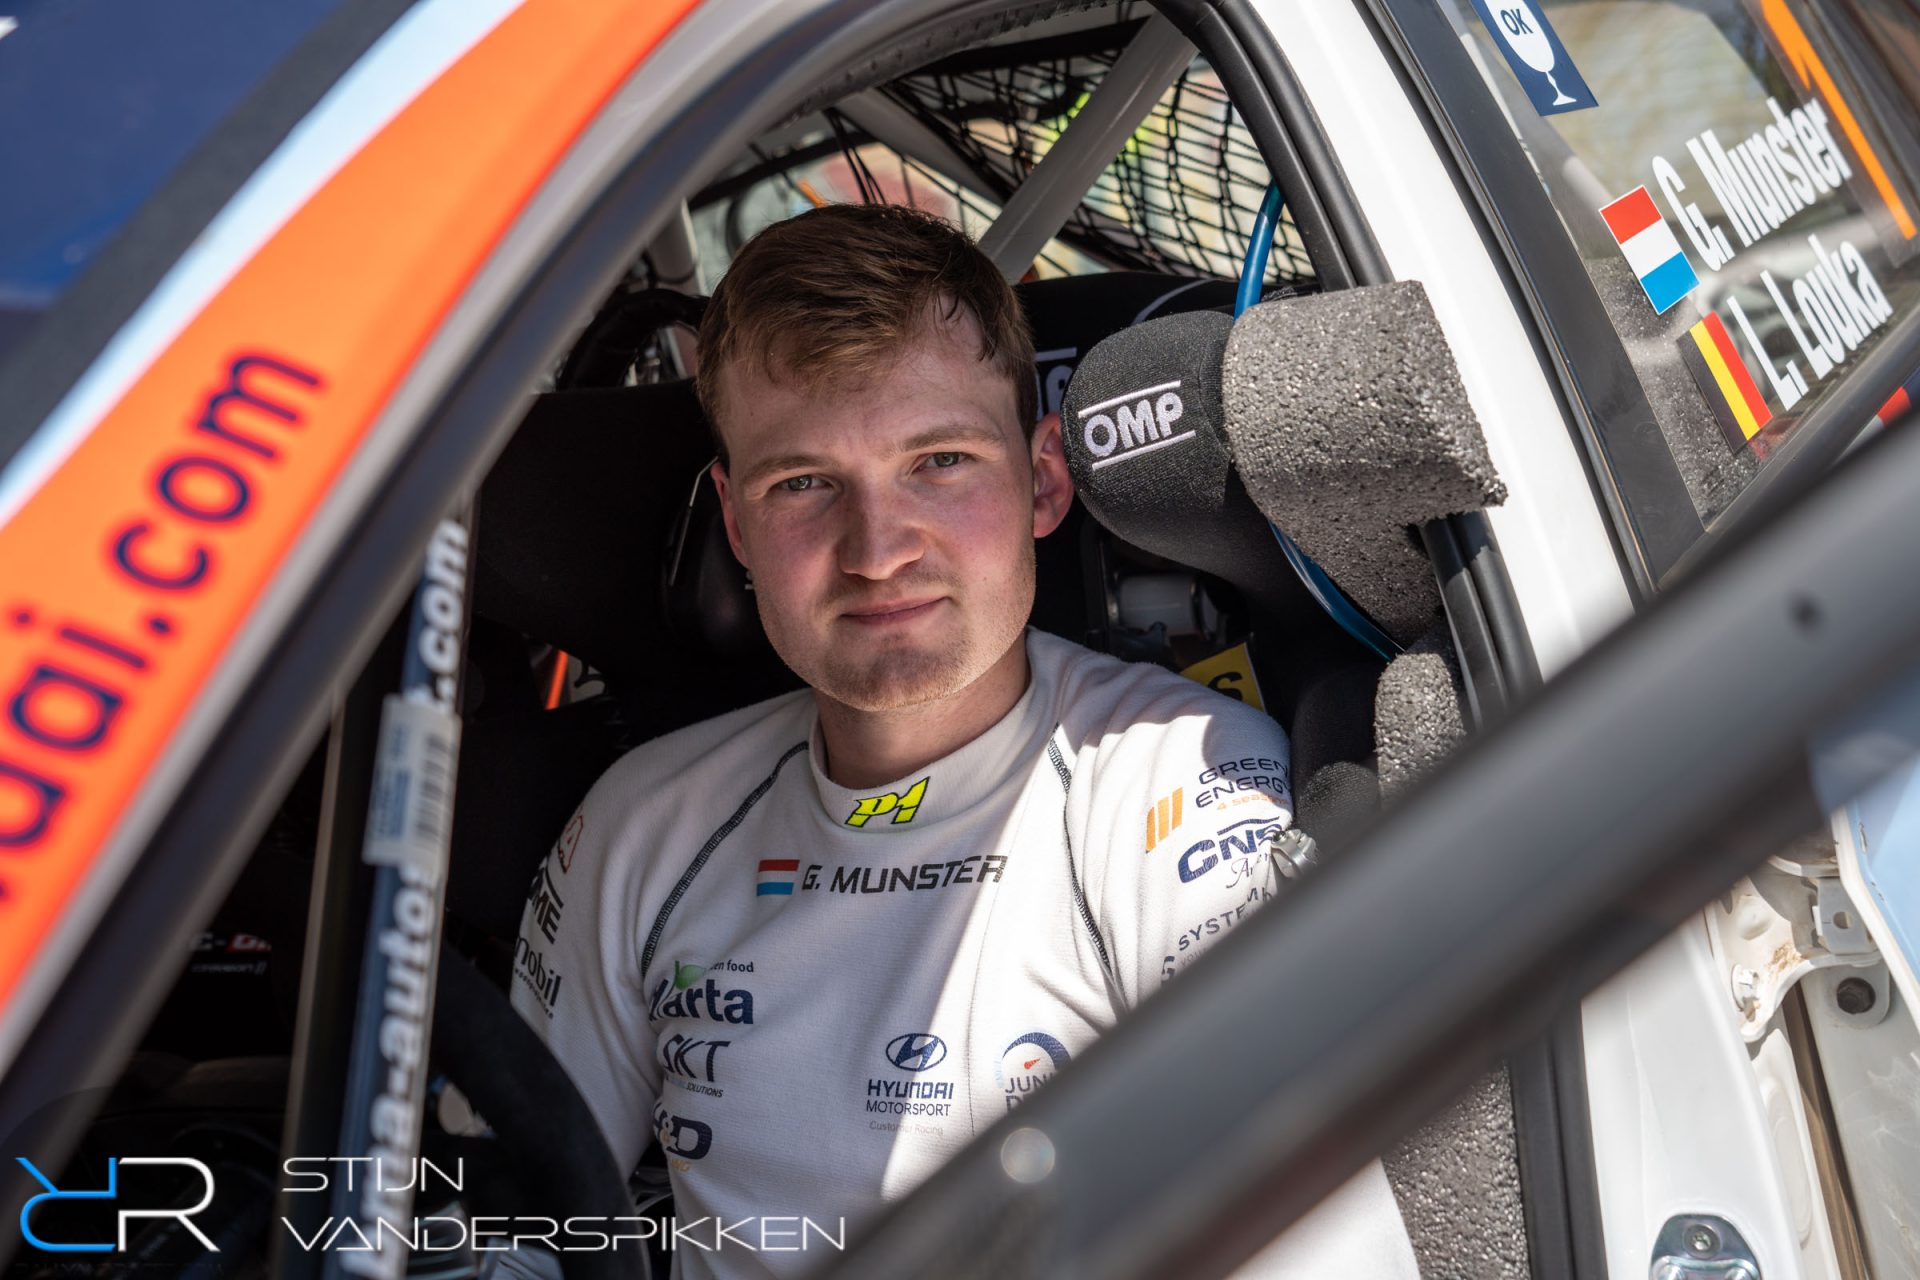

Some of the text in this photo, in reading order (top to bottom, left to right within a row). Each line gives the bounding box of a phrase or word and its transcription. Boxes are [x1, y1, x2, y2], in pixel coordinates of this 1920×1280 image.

[1499, 8, 1534, 36] OK
[1652, 97, 1853, 271] G. Munster
[1727, 234, 1893, 411] L. Louka
[1083, 392, 1184, 458] OMP
[1198, 757, 1289, 786] GREEN
[844, 775, 931, 828] P1
[829, 854, 1008, 894] MUNSTER
[726, 959, 755, 973] food
[685, 1081, 724, 1099] SOLUTIONS
[867, 1079, 954, 1100] HYUNDAI
[1004, 1072, 1054, 1094] JUN
[866, 1099, 952, 1117] MOTORSPORT
